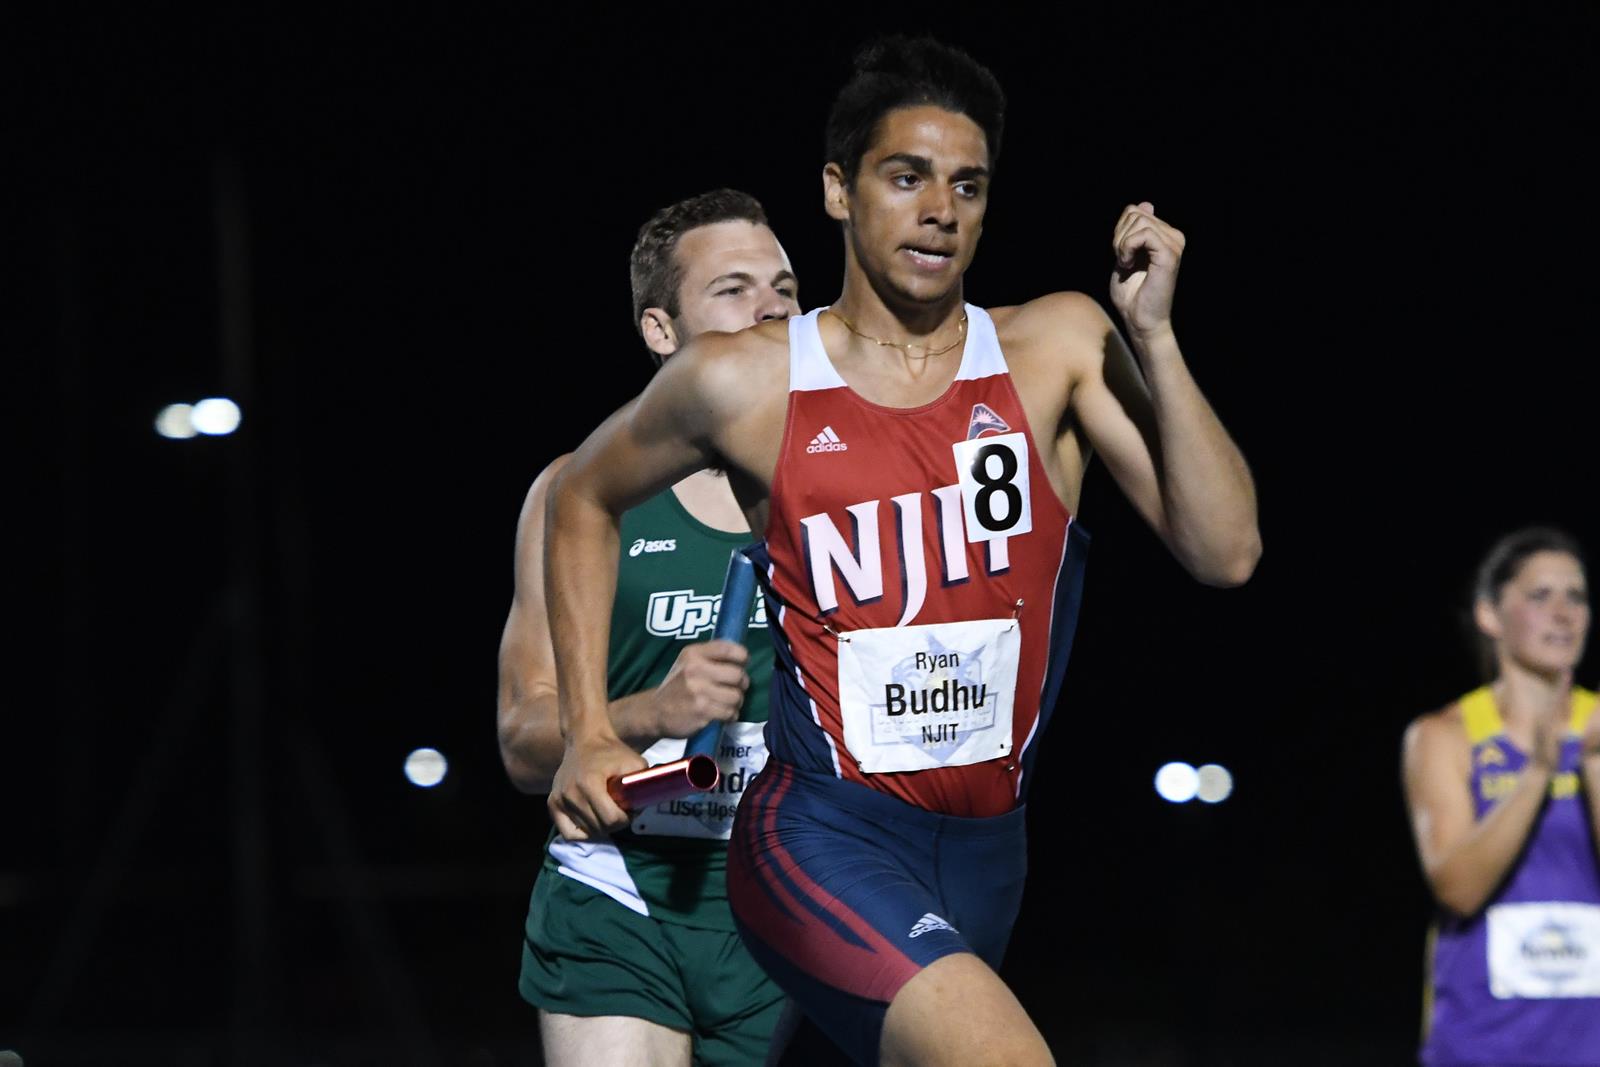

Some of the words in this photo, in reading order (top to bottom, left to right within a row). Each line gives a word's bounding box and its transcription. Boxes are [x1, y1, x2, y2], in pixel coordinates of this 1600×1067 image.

[806, 441, 848, 454] adidas
[970, 443, 1023, 532] 8
[644, 538, 677, 553] asics
[915, 651, 960, 673] Ryan
[885, 679, 987, 717] Budhu
[921, 723, 959, 744] NJIT
[670, 800, 703, 817] USC
